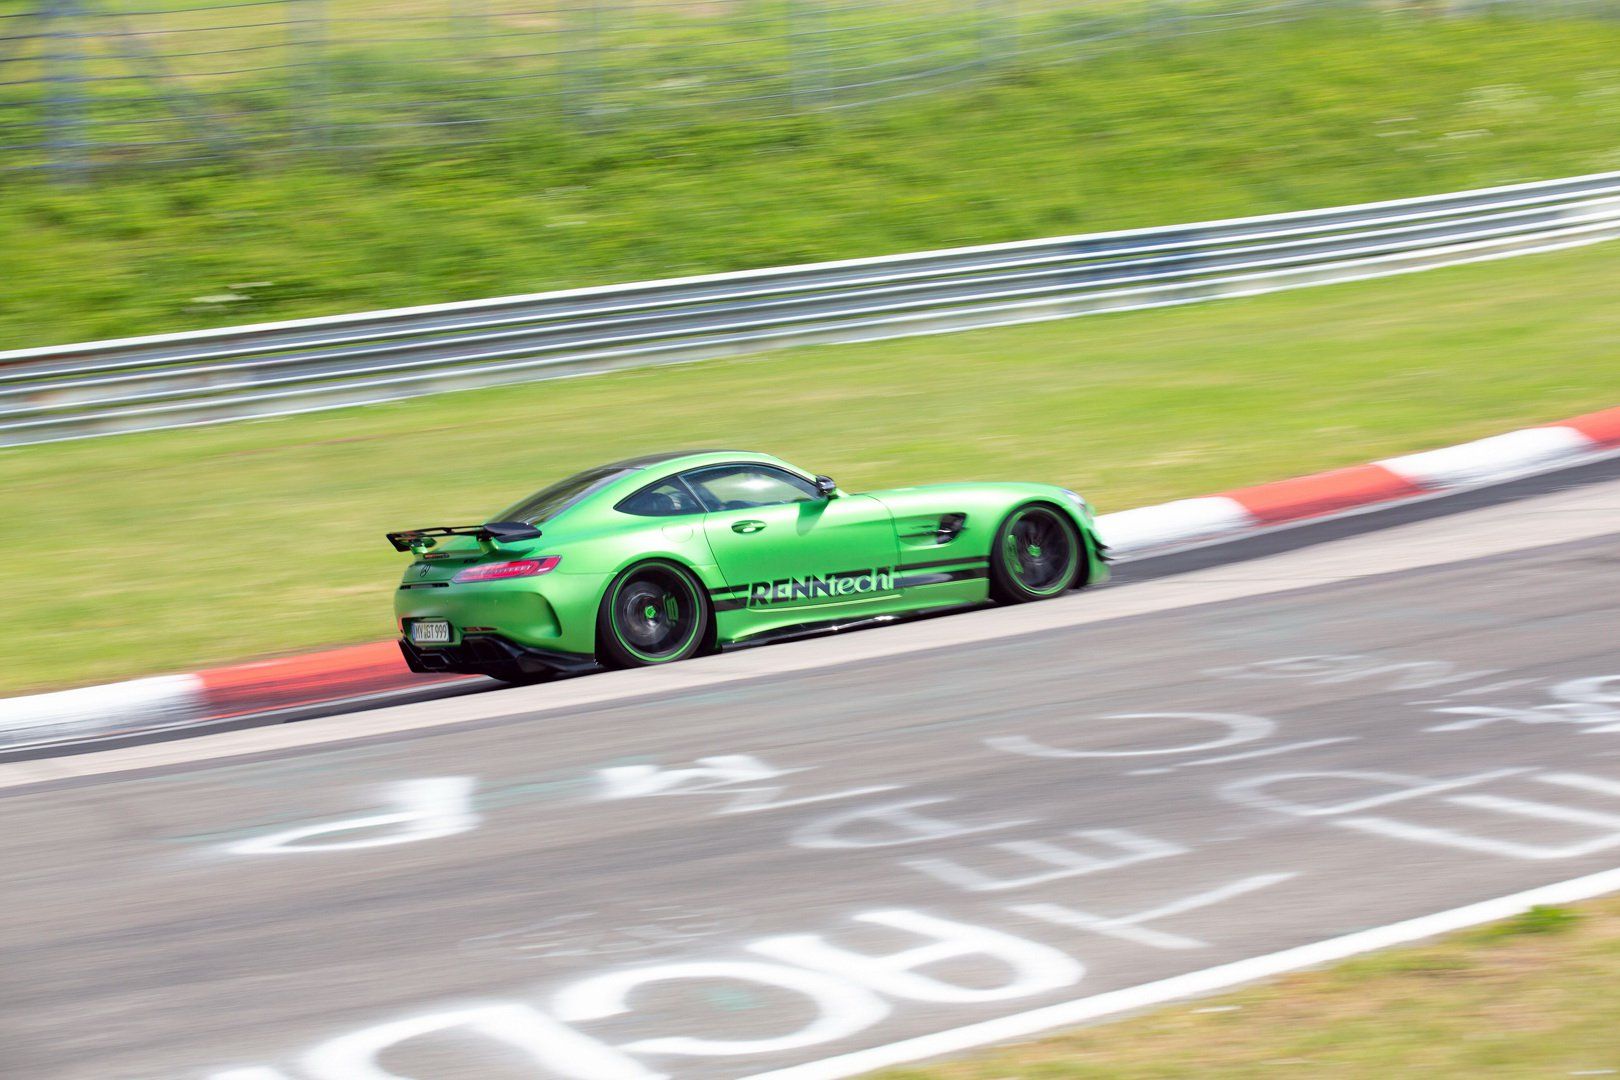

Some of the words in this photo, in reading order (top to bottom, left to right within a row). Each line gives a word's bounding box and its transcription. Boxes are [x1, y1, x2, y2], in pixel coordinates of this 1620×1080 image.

[748, 566, 895, 609] RENNtech
[426, 624, 434, 639] GT
[434, 624, 447, 639] 999
